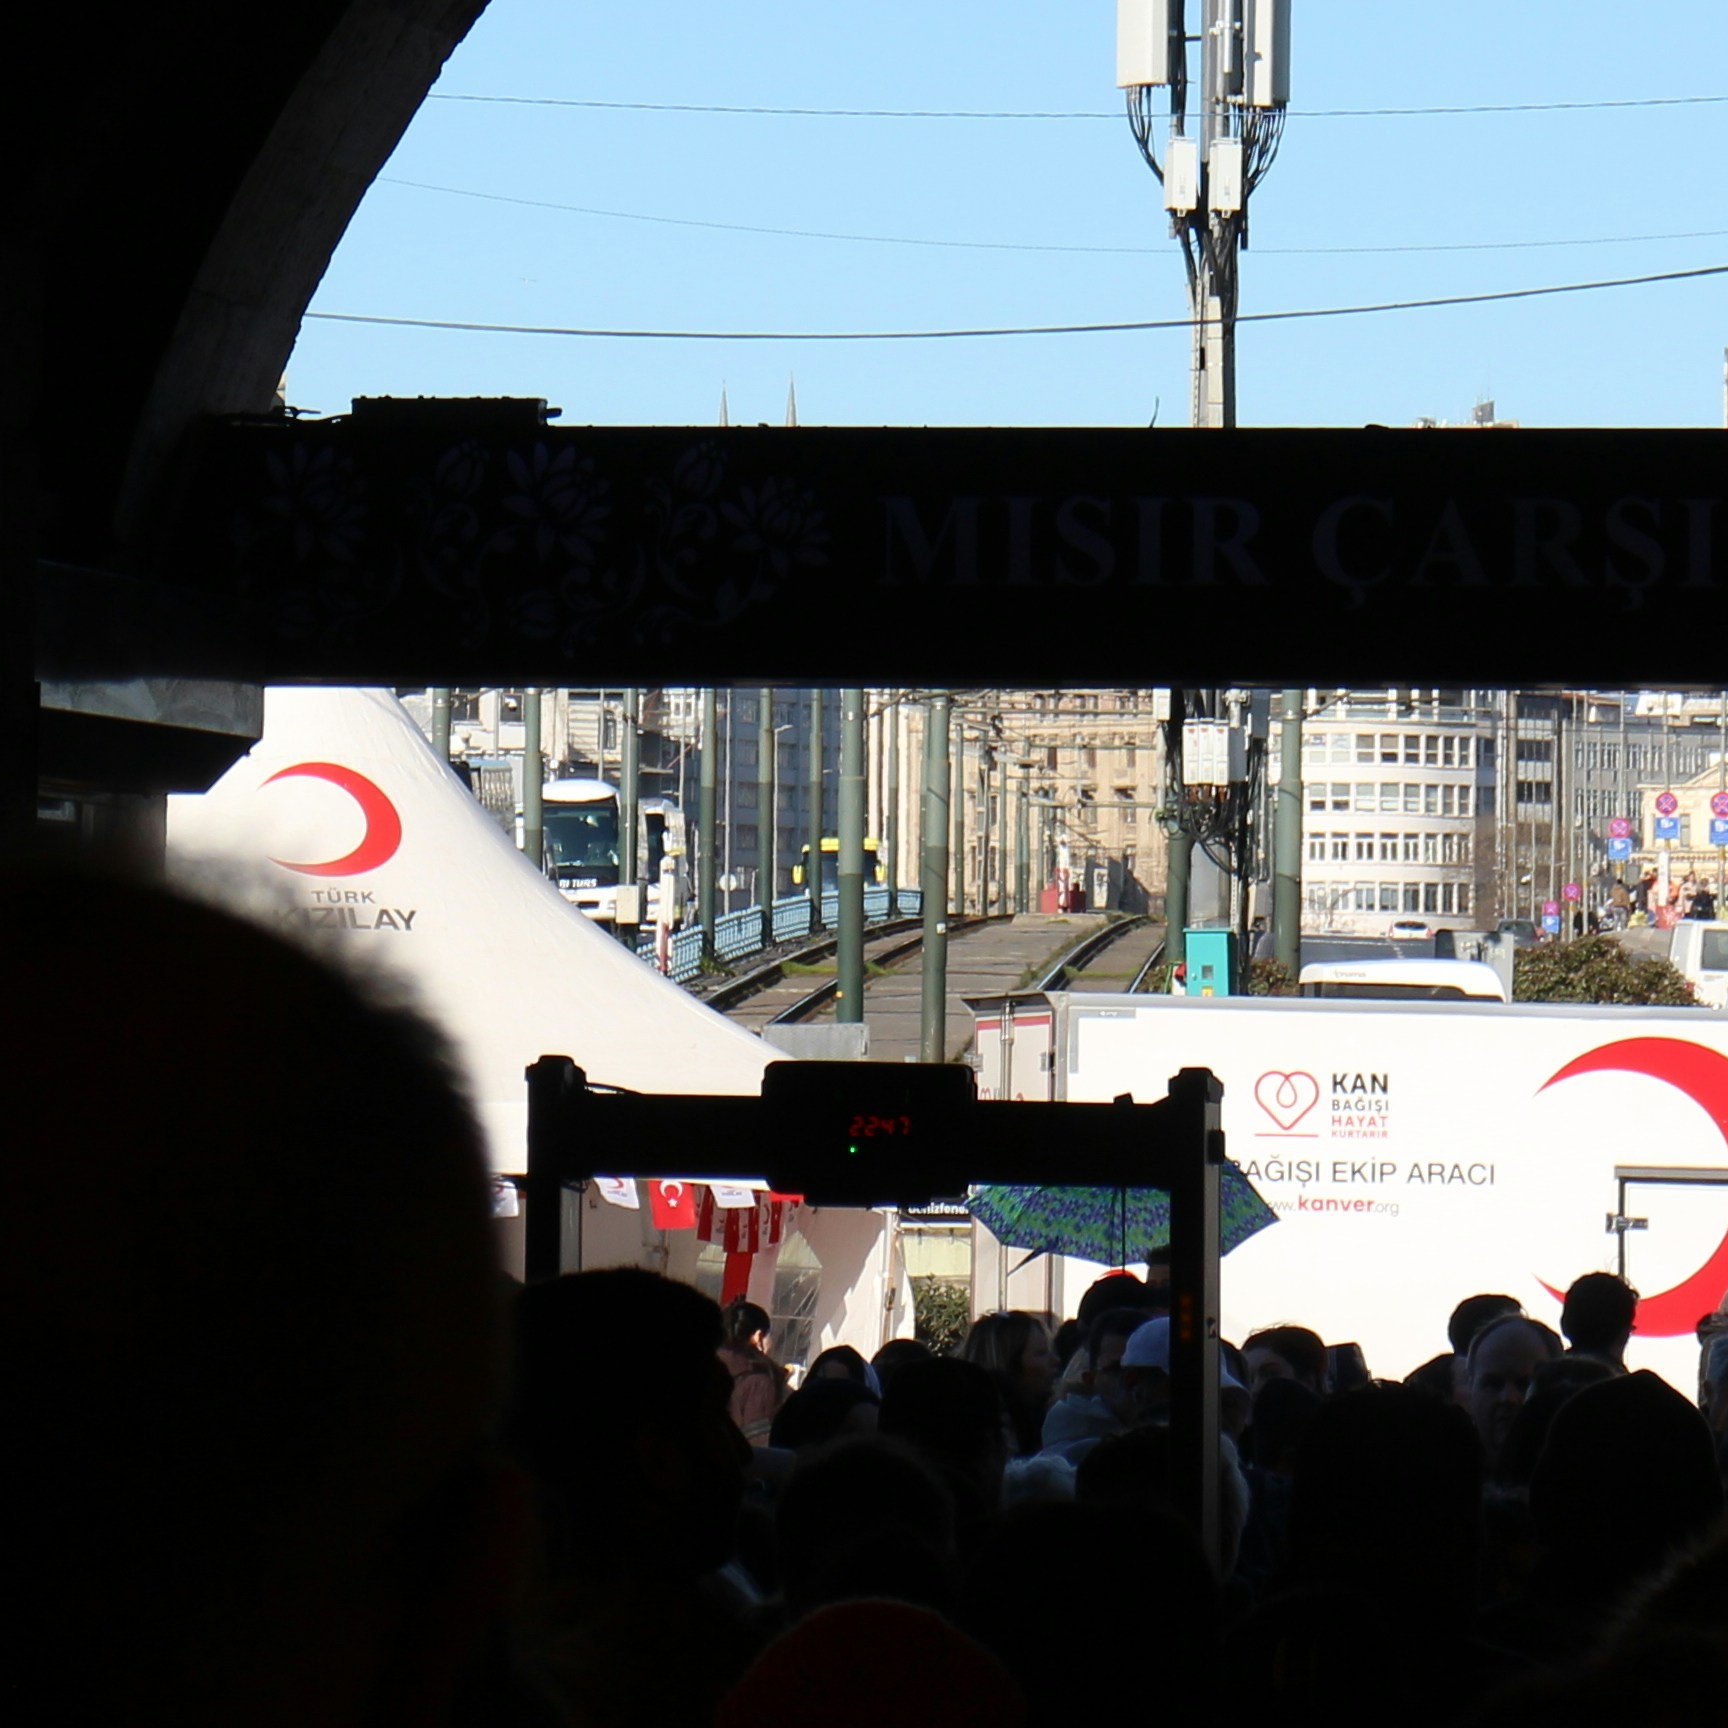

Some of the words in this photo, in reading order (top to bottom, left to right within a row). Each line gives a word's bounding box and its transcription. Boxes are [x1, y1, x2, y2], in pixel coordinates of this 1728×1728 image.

[874, 494, 1272, 586] MISIR
[311, 887, 376, 904] TÜRK
[1331, 1073, 1389, 1095] KAN
[1331, 1096, 1390, 1114] BAĞIŞI
[848, 1113, 913, 1138] 2247
[1331, 1115, 1389, 1128] HAYAT
[1331, 1129, 1389, 1139] KURTARIR
[1332, 1156, 1397, 1184] EKİP
[1405, 1162, 1495, 1186] ARACI
